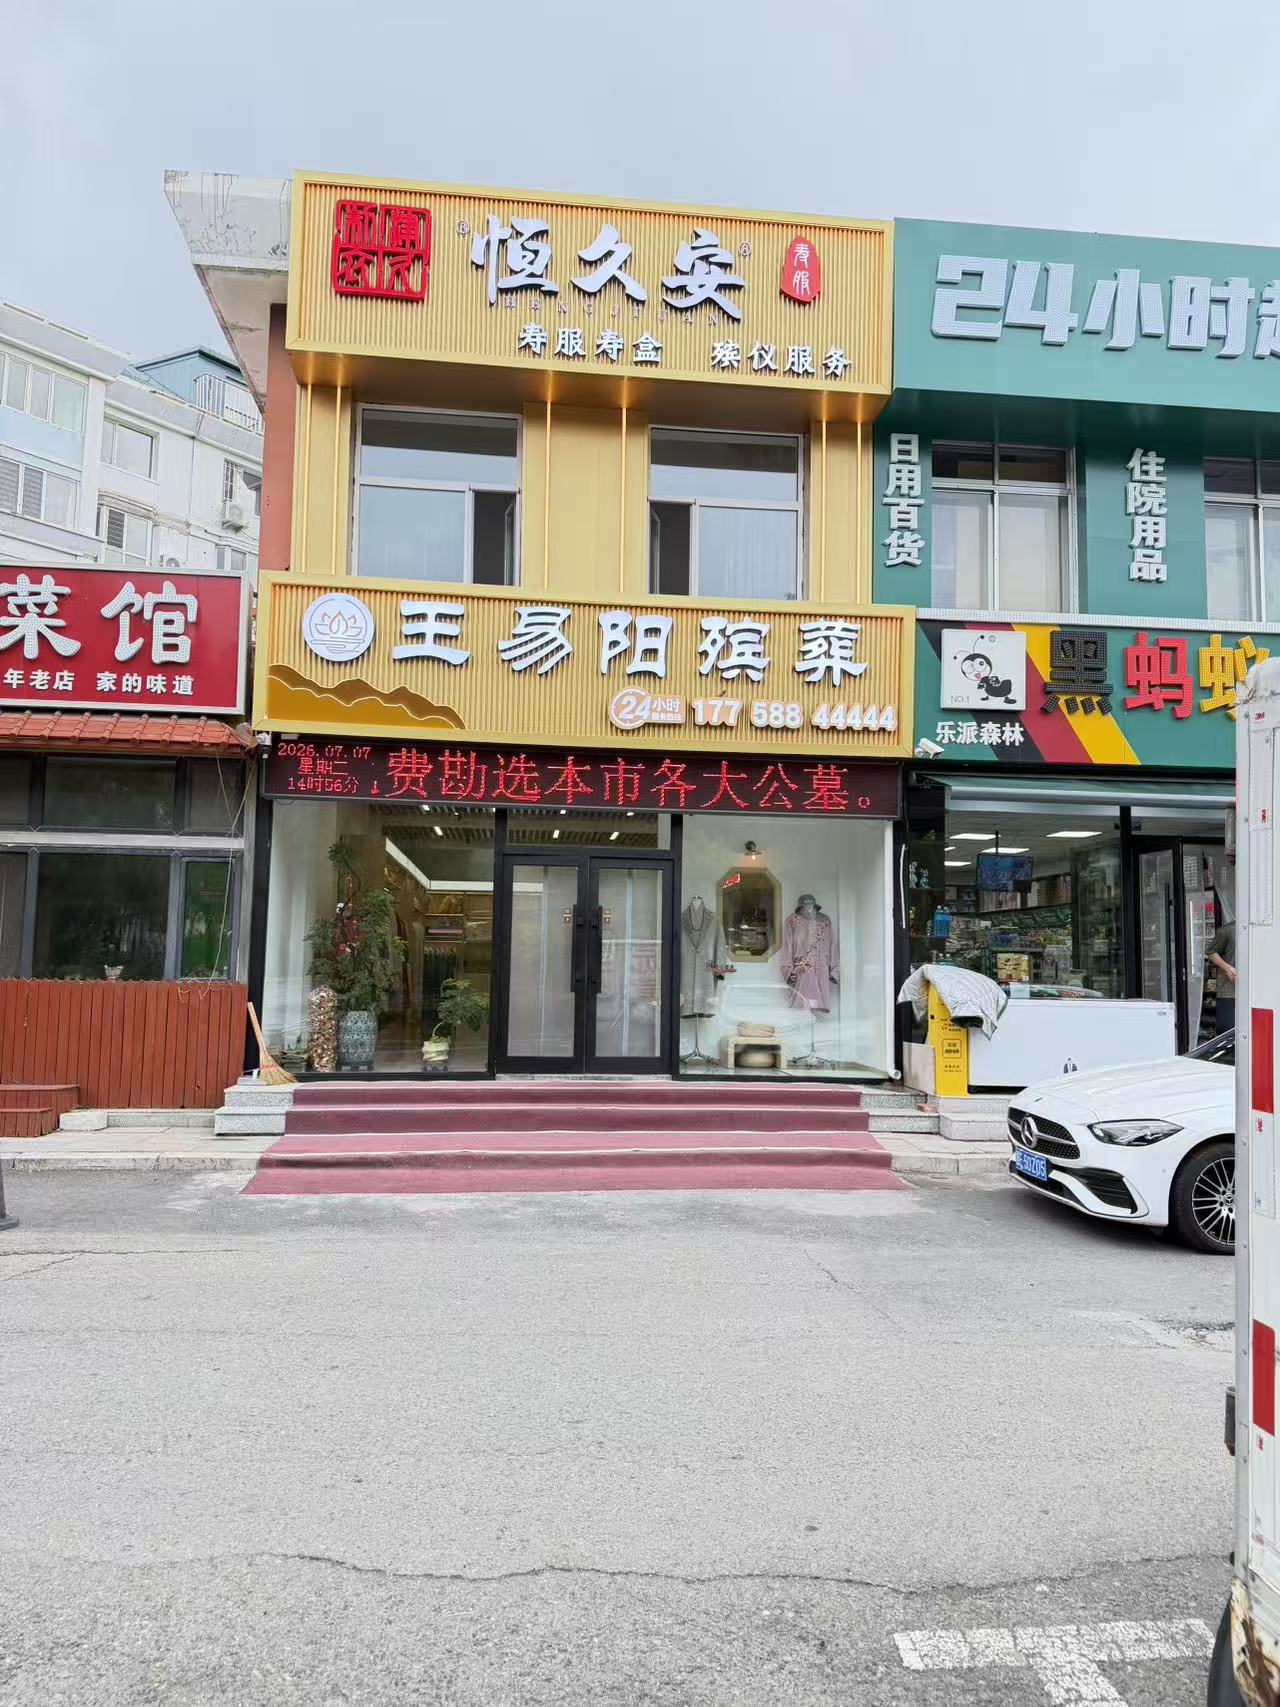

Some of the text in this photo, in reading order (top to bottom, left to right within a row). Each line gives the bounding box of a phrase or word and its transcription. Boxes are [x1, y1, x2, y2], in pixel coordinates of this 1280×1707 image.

[470, 213, 745, 319] 恒久安
[518, 323, 851, 376] 寿服寿盒 殡仪服务
[882, 433, 924, 567] 日用百货
[1125, 448, 1168, 582] 住院用品
[0, 573, 198, 664] 菜馆
[392, 601, 868, 687] 王易阳殡葬
[4, 667, 194, 696] 年老店 家的味道
[692, 700, 742, 724] 177
[753, 702, 801, 727] 588
[814, 703, 895, 730] 44444
[935, 721, 1024, 746] 乐派森林
[278, 743, 371, 759] 2026.07.07
[298, 759, 348, 776] 星期二
[288, 777, 359, 793] 14时56分
[371, 748, 870, 810] 费勘选本市各大公墓。
